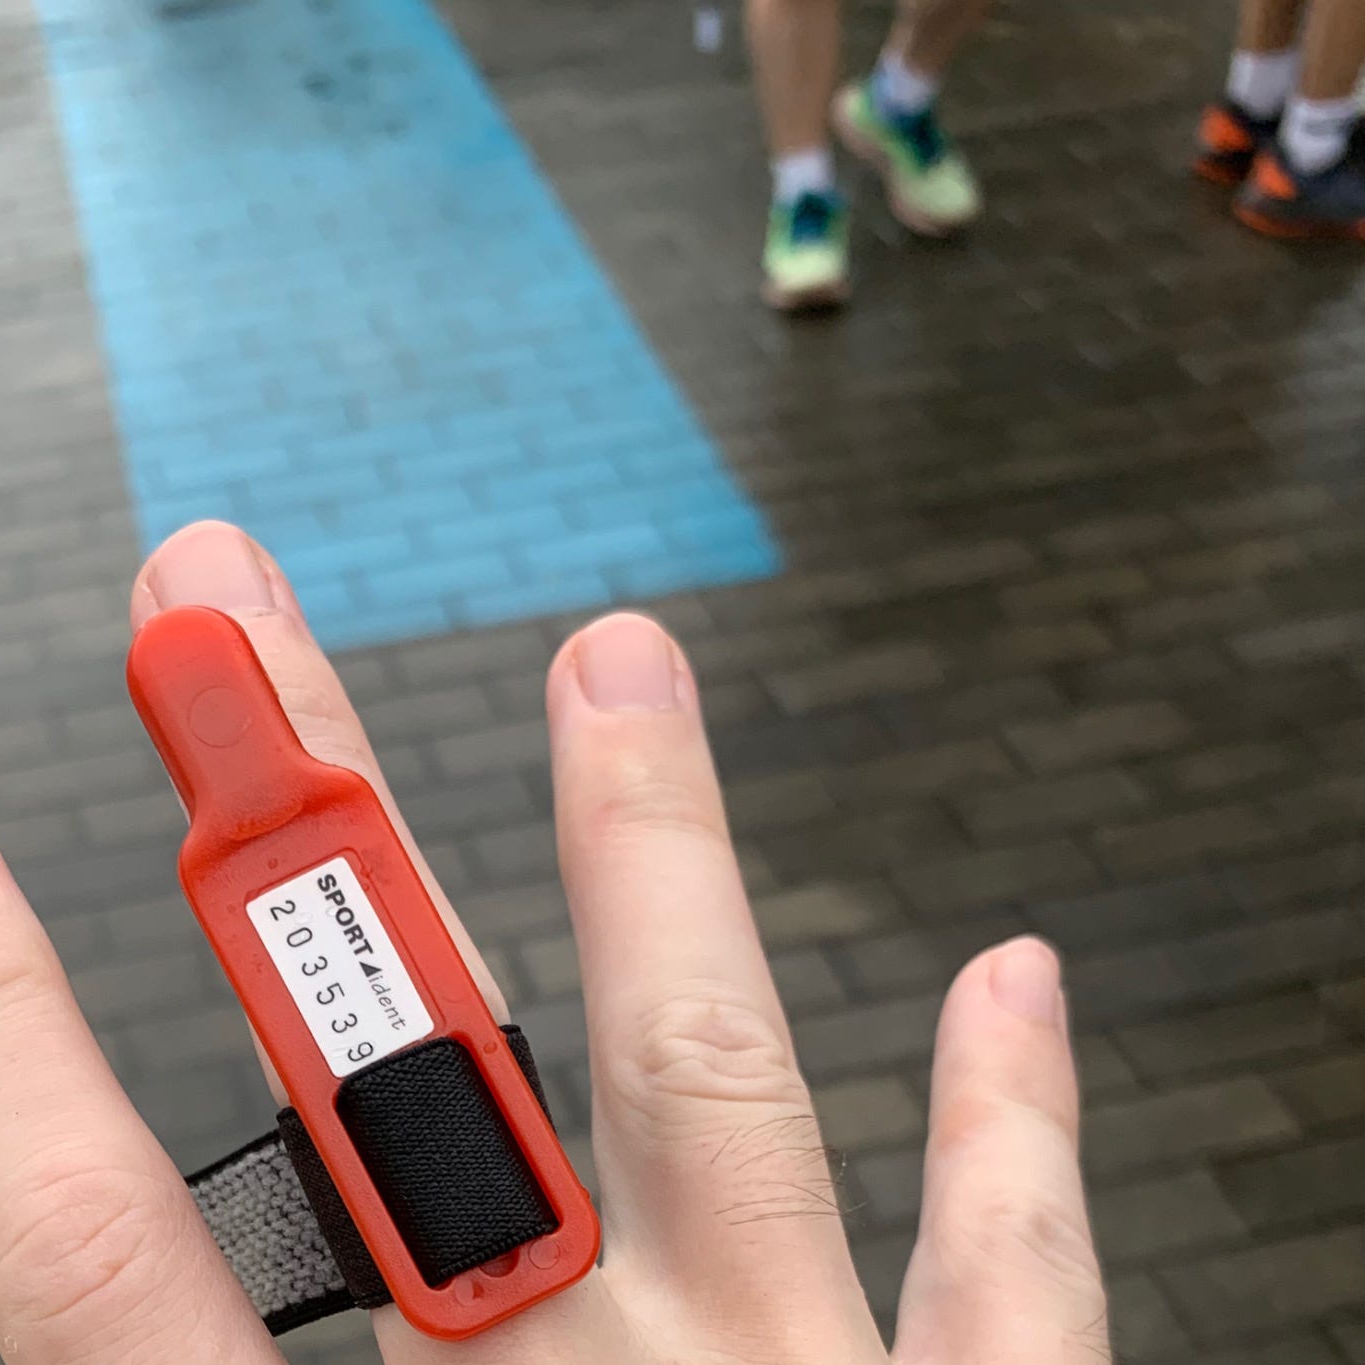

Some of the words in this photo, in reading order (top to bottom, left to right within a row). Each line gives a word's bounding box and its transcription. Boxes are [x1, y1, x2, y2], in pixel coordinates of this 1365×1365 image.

[269, 900, 375, 1062] 203539
[317, 873, 374, 956] SPORT
[368, 974, 407, 1032] ident
